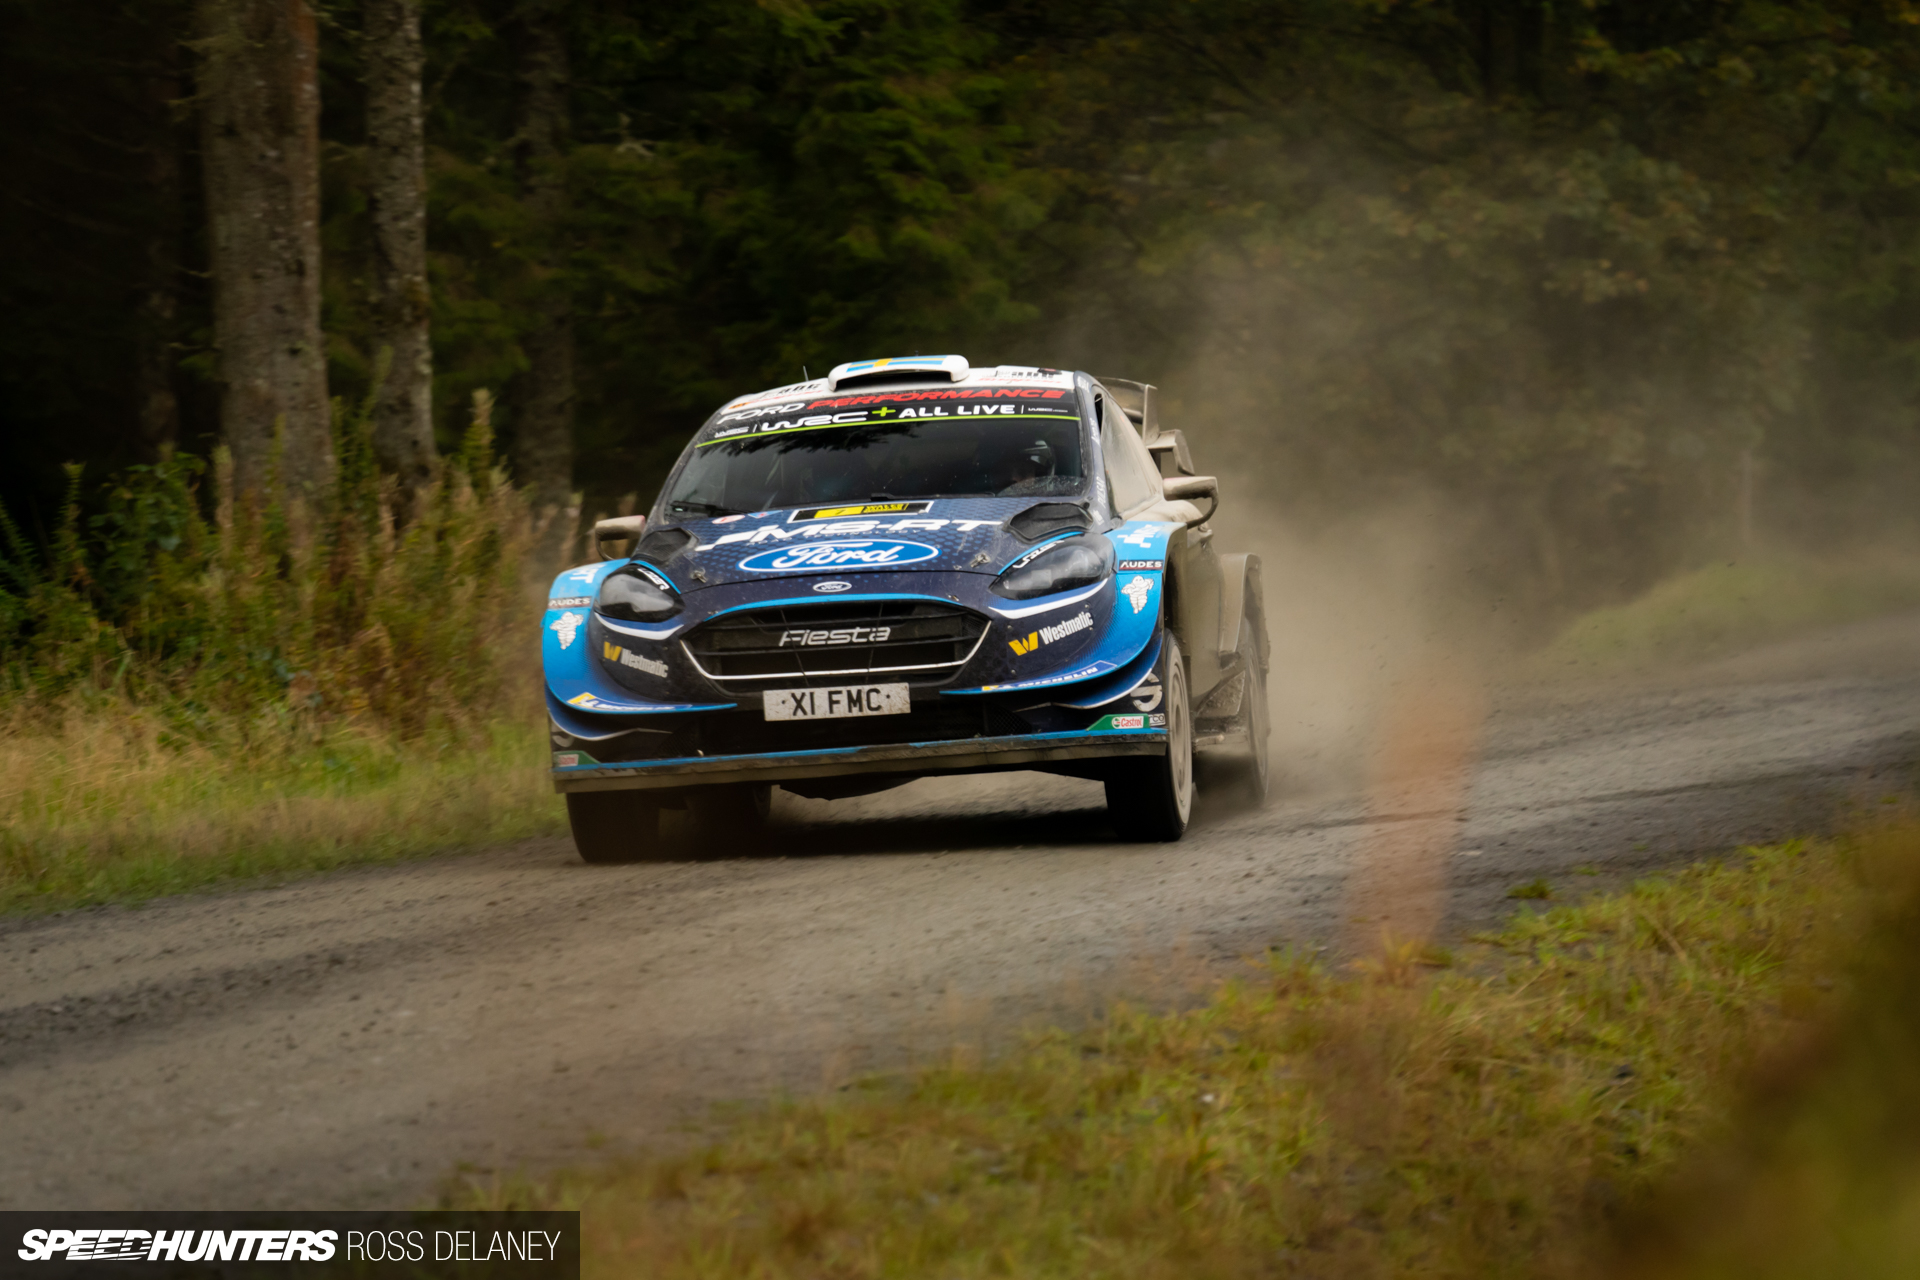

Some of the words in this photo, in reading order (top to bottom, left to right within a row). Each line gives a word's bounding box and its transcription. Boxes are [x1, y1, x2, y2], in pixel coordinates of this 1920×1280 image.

[716, 402, 806, 425] FORD
[806, 389, 1066, 410] PERFORMANCE
[899, 406, 949, 418] ALL
[957, 404, 1015, 415] LIVE
[771, 541, 905, 569] Ford
[1120, 560, 1163, 569] AUDES
[548, 597, 591, 607] AUDES
[778, 626, 892, 647] Fiesta
[1038, 611, 1094, 645] Westmatic
[620, 648, 669, 678] Westmatic
[828, 688, 882, 715] FMC
[1120, 717, 1143, 728] Castrol
